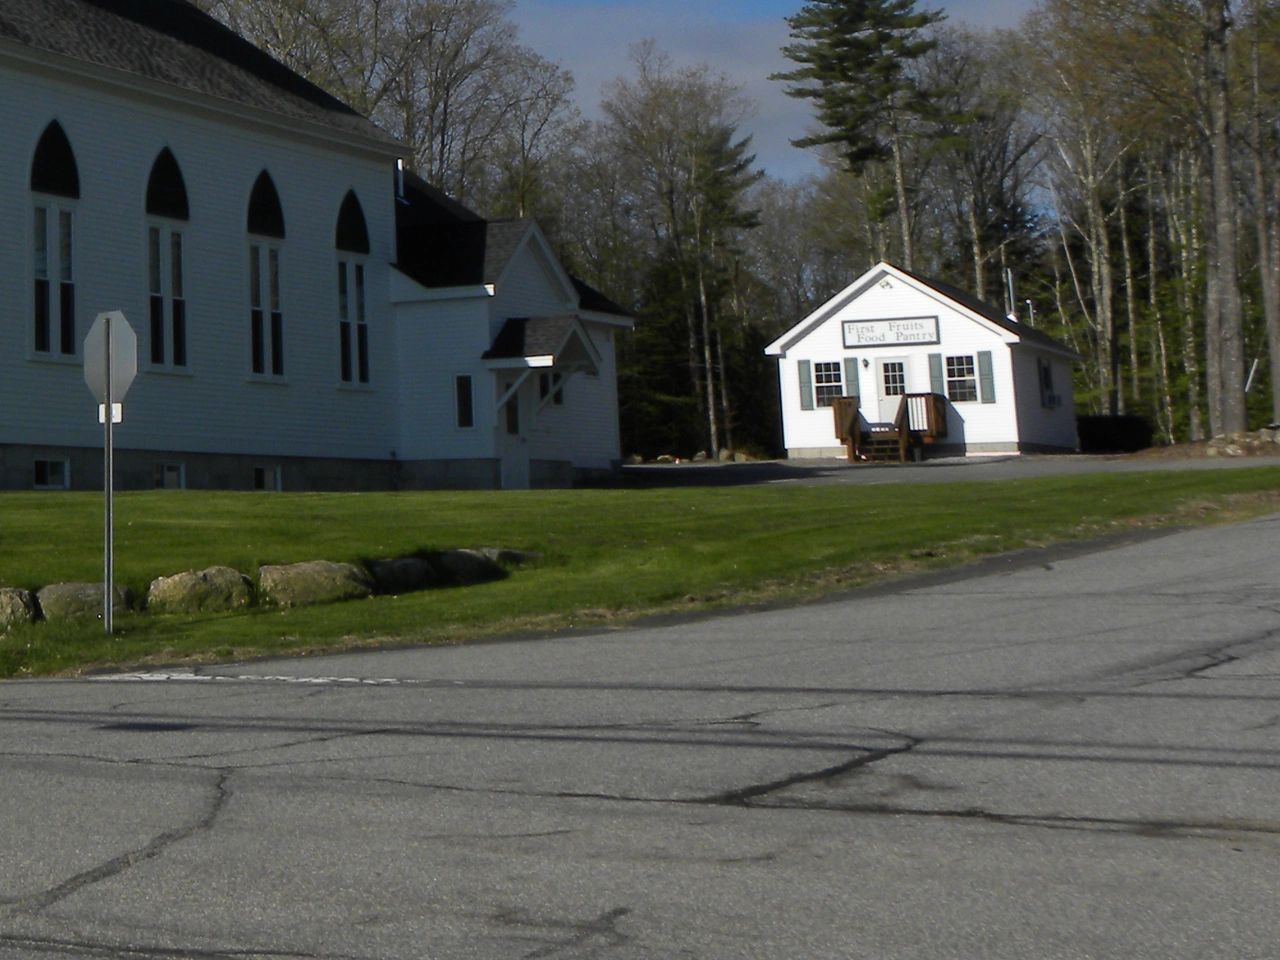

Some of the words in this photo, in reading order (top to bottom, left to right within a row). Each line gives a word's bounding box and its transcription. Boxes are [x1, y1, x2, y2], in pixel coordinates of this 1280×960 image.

[847, 324, 875, 335] First
[888, 321, 924, 332] Fruits
[857, 332, 885, 344] Food
[895, 331, 935, 342] Pantry
